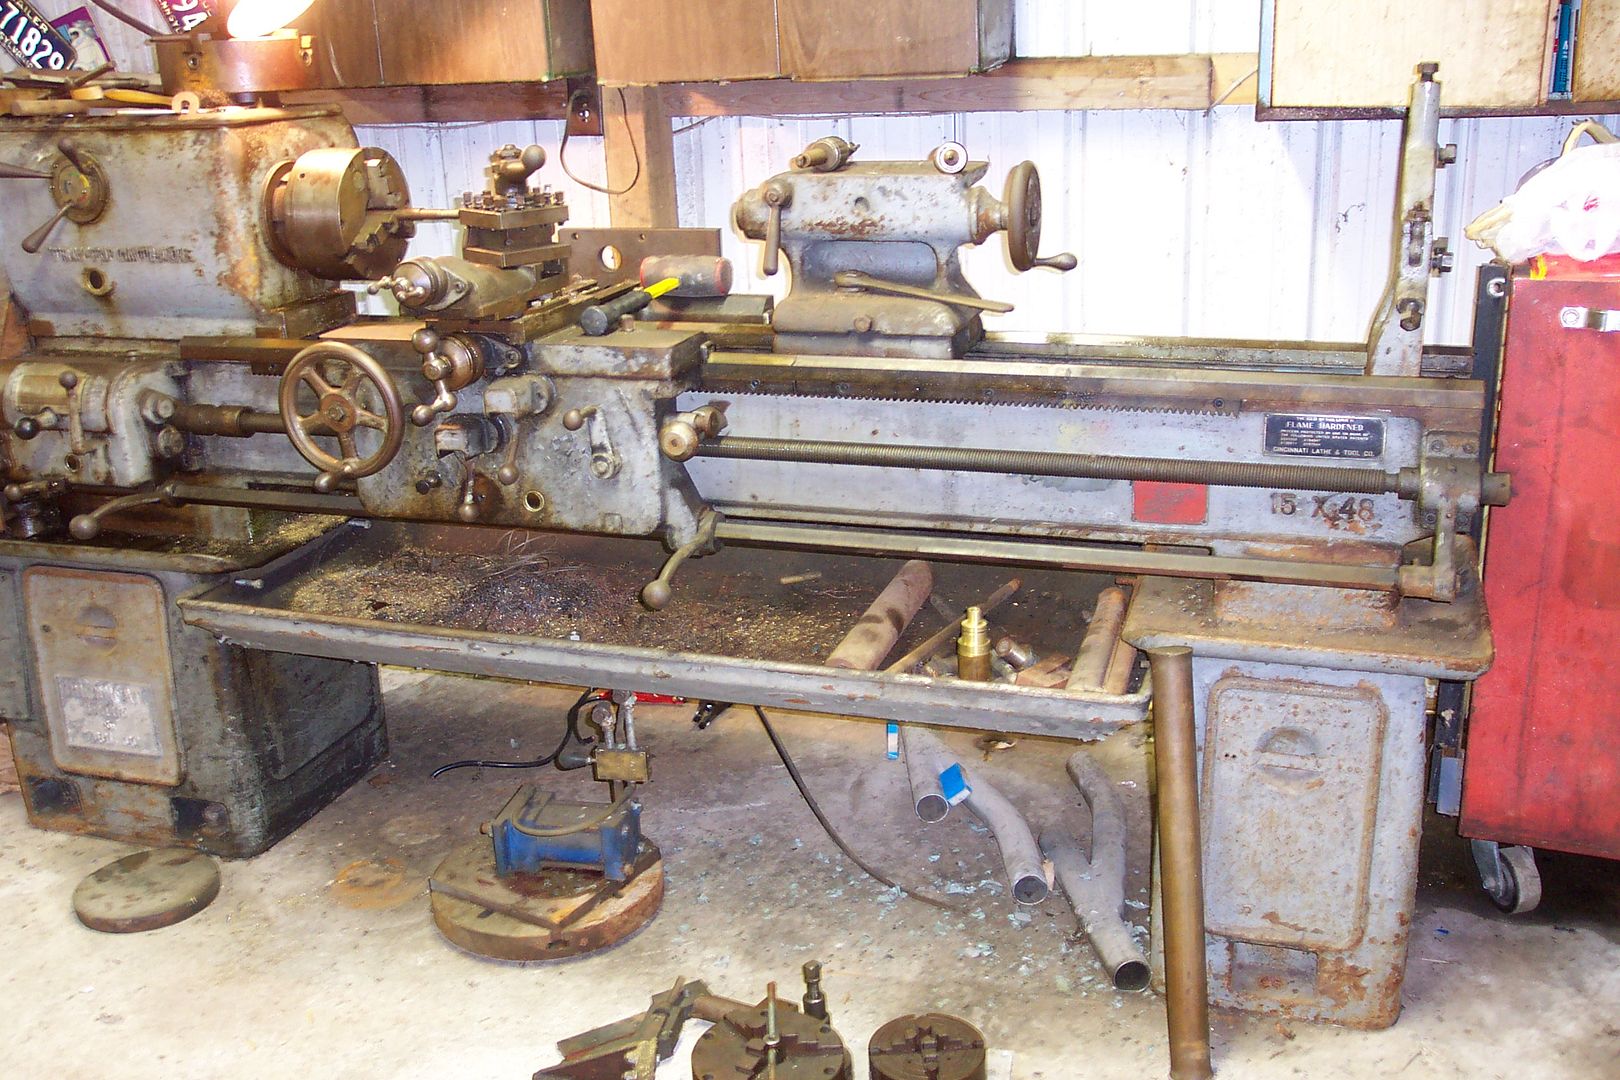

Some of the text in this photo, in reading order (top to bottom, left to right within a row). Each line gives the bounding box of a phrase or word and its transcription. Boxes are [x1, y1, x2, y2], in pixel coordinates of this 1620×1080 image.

[11, 0, 49, 34] AILER
[172, 0, 209, 32] 94
[0, 1, 65, 71] 71820
[1286, 421, 1364, 431] FLAME HARDENED
[1343, 449, 1361, 457] TOOL
[1270, 493, 1297, 516] 15
[1339, 497, 1375, 522] 48
